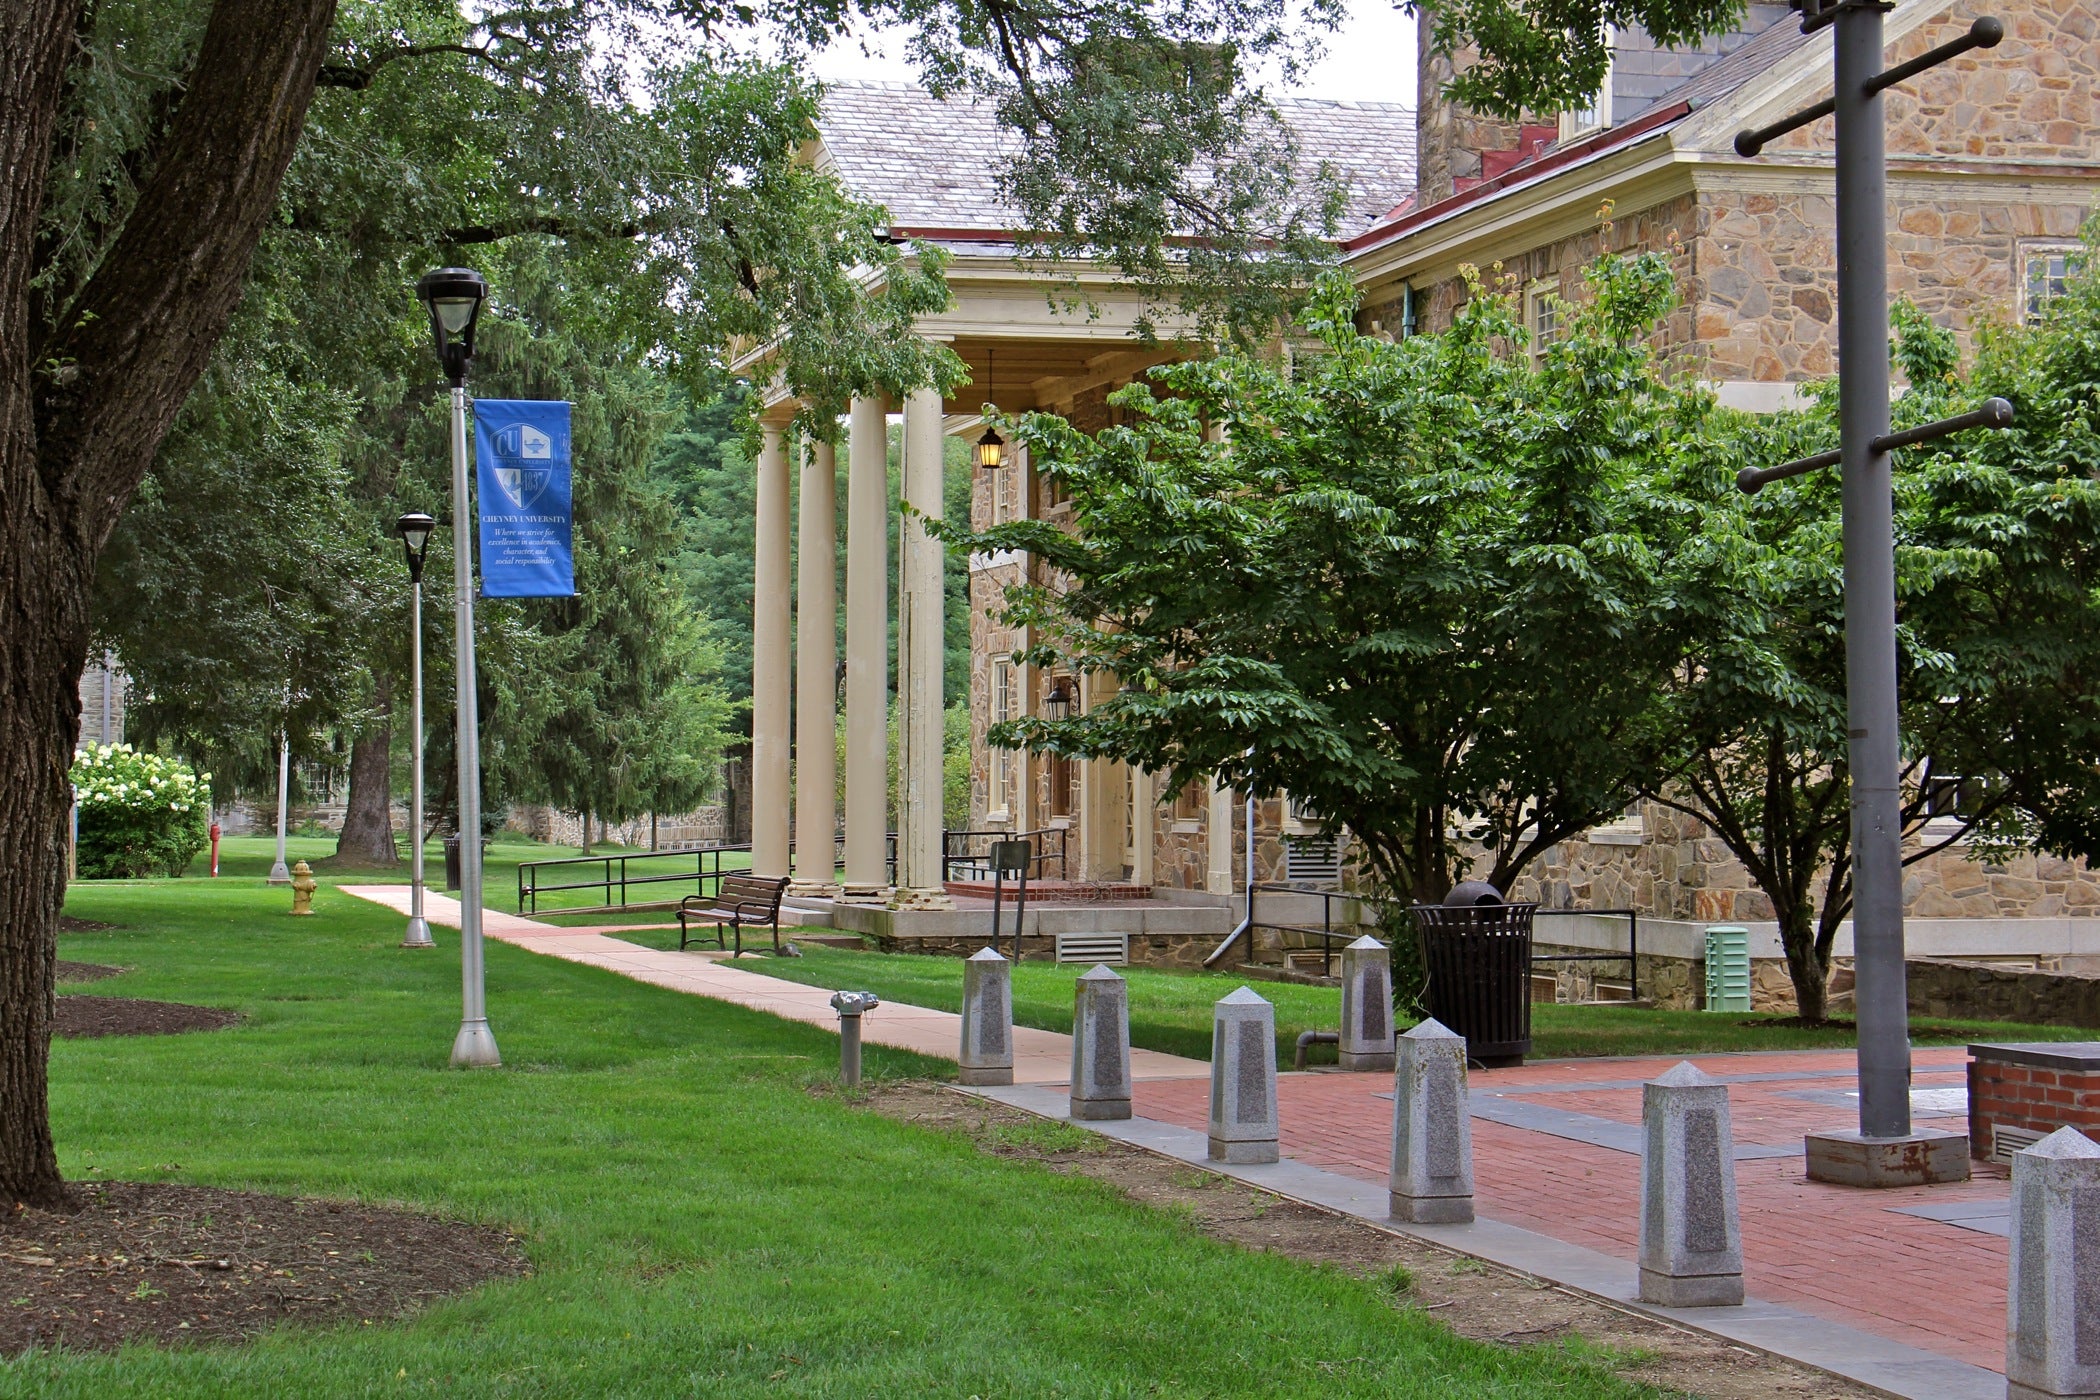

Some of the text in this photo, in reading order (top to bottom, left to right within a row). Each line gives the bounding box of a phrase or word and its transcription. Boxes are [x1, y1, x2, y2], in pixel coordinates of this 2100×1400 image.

[496, 430, 517, 455] CU
[524, 472, 543, 491] 1837
[520, 515, 565, 523] UNIVERSITY
[495, 528, 516, 536] Where
[527, 528, 543, 536] strive
[544, 528, 554, 537] for
[503, 547, 534, 555] character,
[515, 557, 555, 566] responsibility
